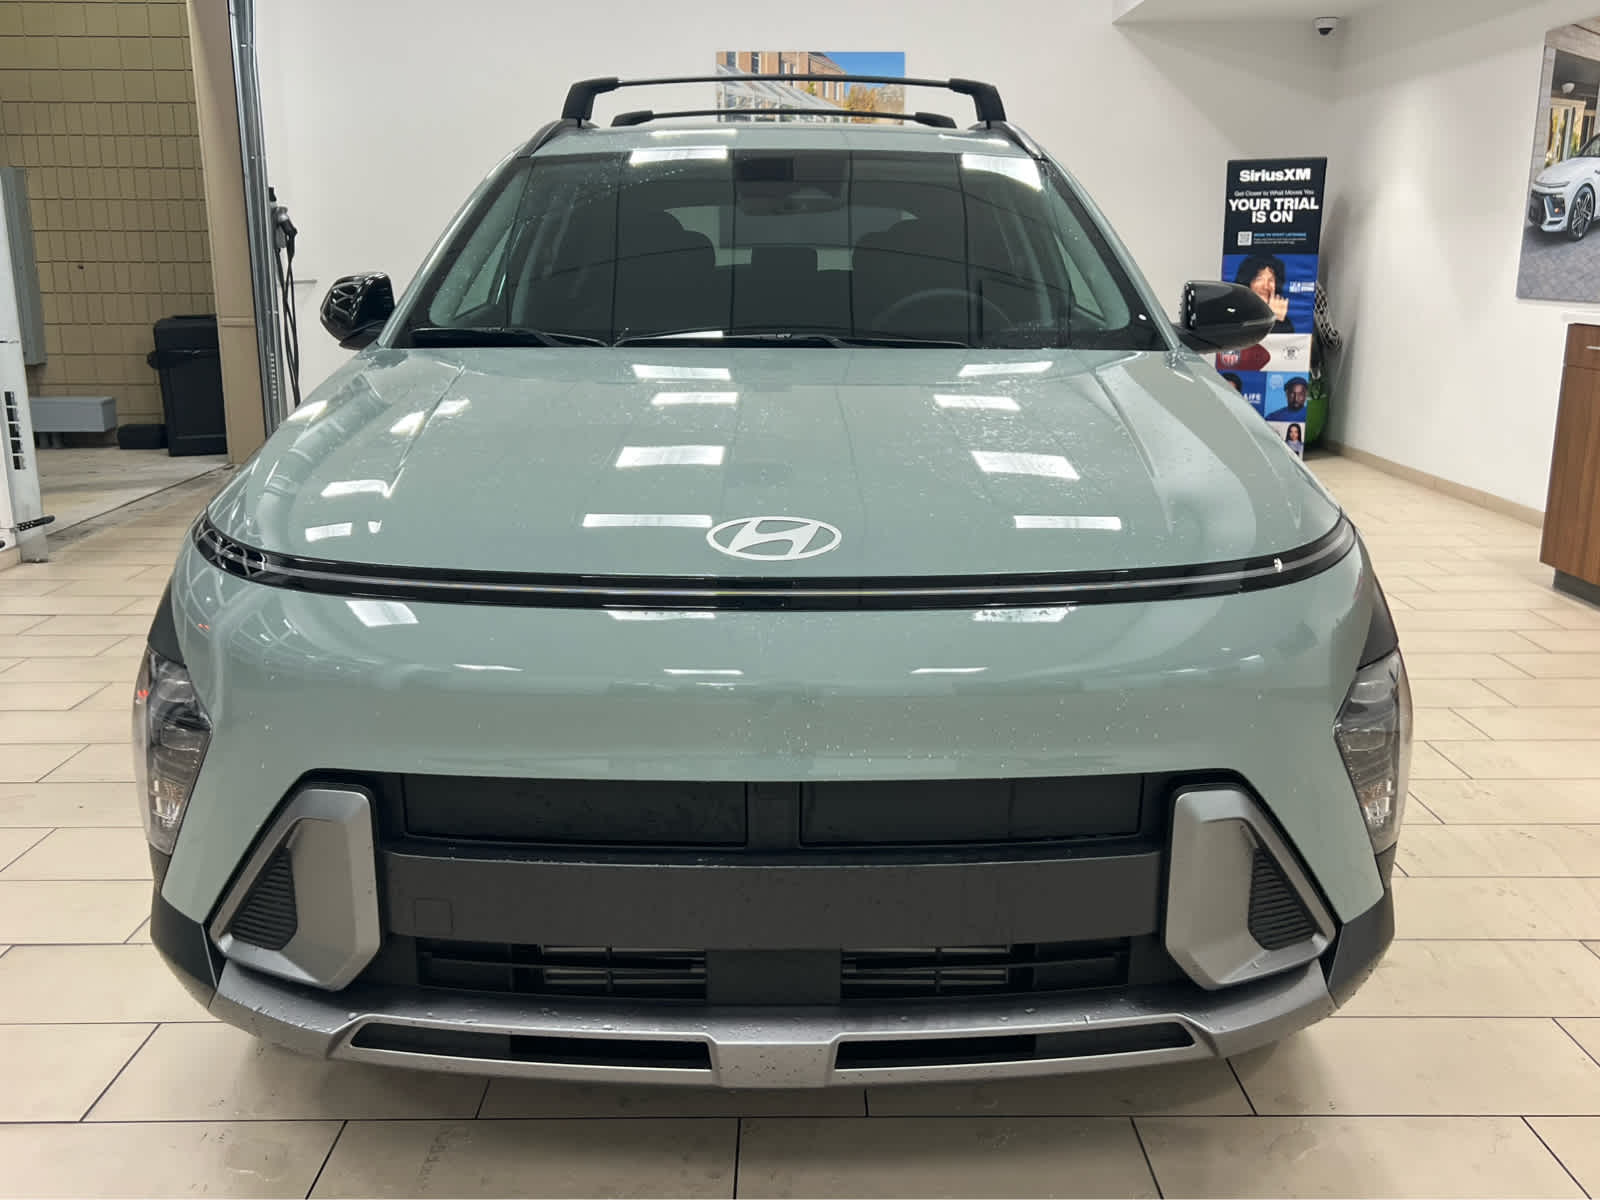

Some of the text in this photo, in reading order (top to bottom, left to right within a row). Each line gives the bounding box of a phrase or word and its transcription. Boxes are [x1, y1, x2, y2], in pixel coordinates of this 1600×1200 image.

[1239, 168, 1311, 182] SiriusXM
[1228, 197, 1319, 211] YOUR TRIAL
[1252, 210, 1293, 223] IS ON
